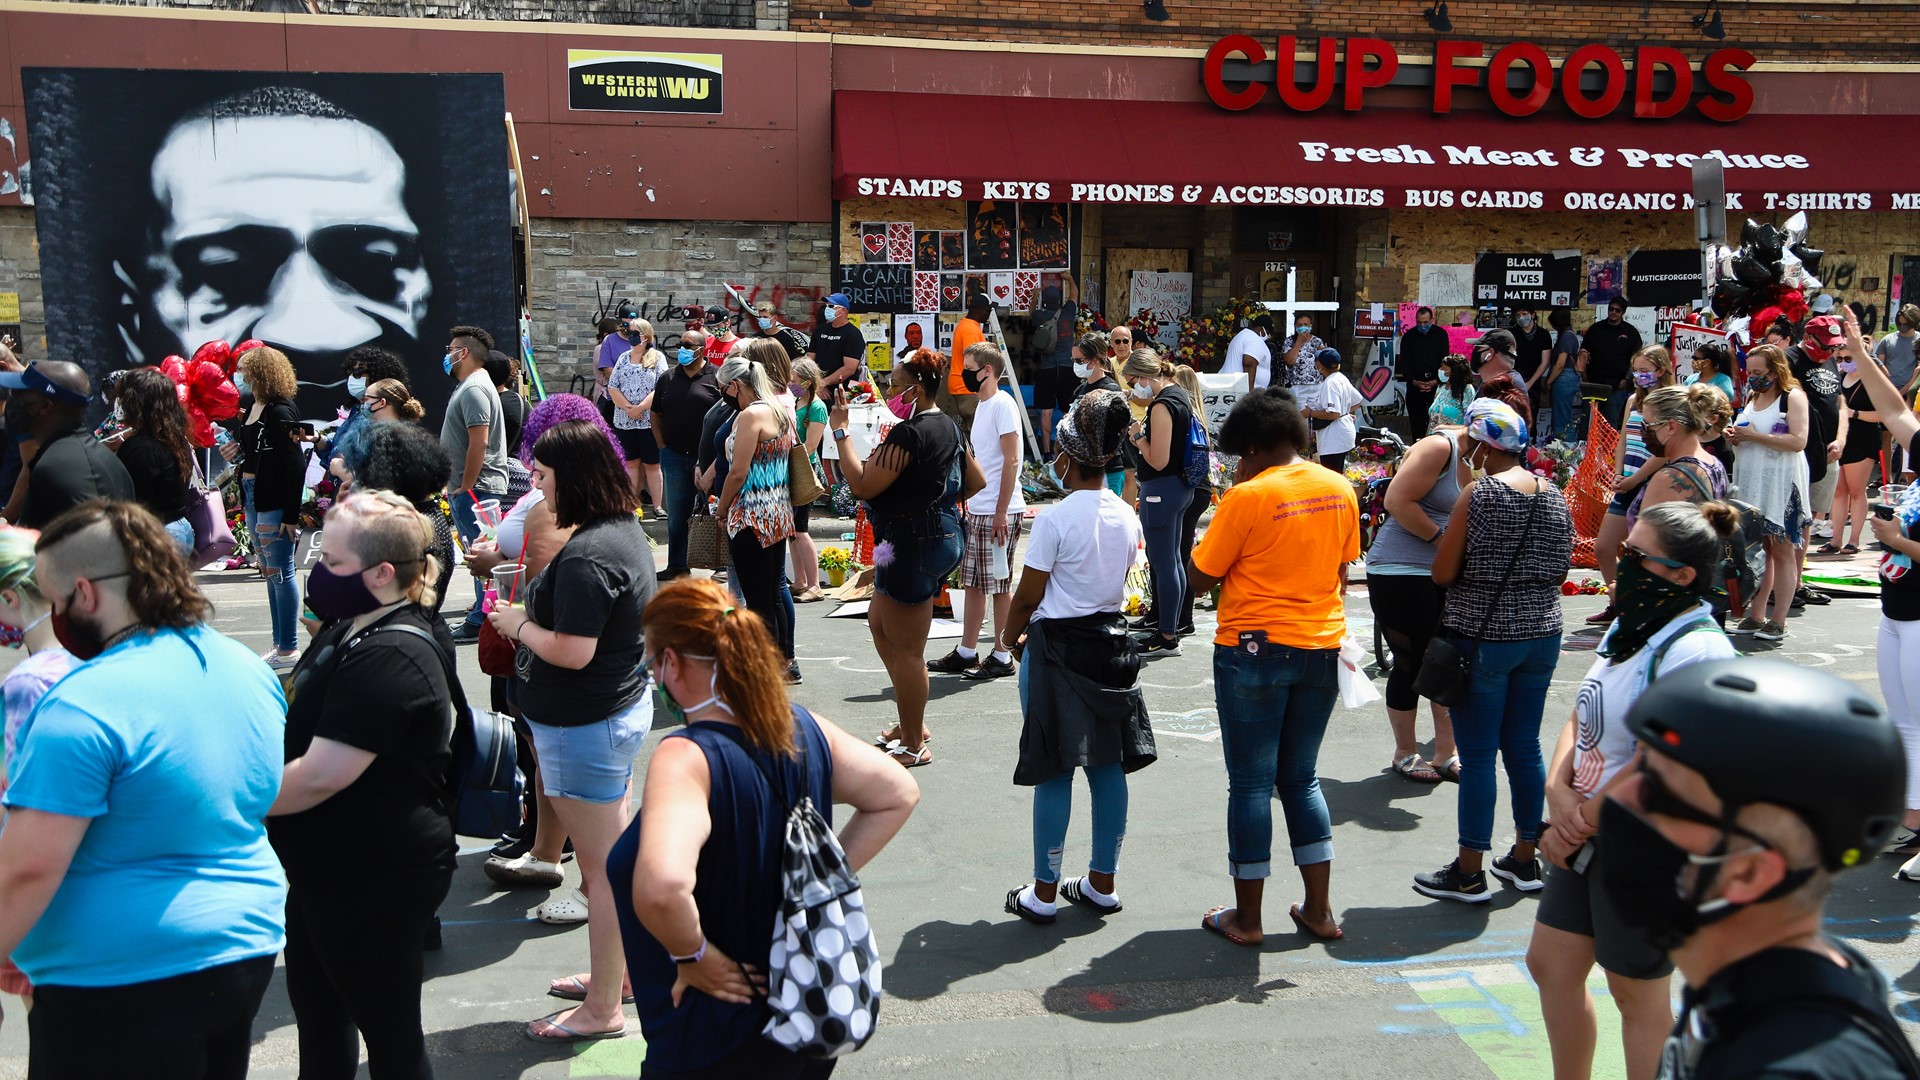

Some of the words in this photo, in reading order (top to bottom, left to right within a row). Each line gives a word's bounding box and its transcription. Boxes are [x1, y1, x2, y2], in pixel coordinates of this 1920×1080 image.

[582, 74, 657, 87] WESTERN
[1204, 34, 1399, 112] CUP
[1433, 40, 1757, 122] FOODS
[606, 86, 657, 98] UNION
[666, 77, 709, 99] WU
[1298, 141, 1434, 165] Fresh
[1442, 145, 1558, 168] Meat
[1570, 147, 1604, 167] &
[858, 177, 963, 198] STAMPS
[983, 181, 1050, 201] KEYS
[1071, 183, 1174, 203] PHONES
[1182, 186, 1203, 203] &
[1210, 186, 1384, 206] ACCESSORIES
[1405, 189, 1455, 208] BUS
[1461, 190, 1544, 209] CARDS
[1564, 192, 1675, 210] ORGANIC
[1682, 193, 1743, 210] MK
[1764, 193, 1872, 210] T-SHIRTS
[1507, 258, 1543, 268] BLACK
[841, 267, 854, 283] I
[1135, 273, 1150, 288] No
[1422, 272, 1458, 287] #TEAM
[1510, 274, 1540, 284] LIVES
[1631, 274, 1703, 282] #JUSTICEFORGEORG
[842, 286, 913, 305] BREATHE
[1133, 287, 1148, 303] No
[1425, 289, 1466, 303] HUMAN
[1504, 290, 1547, 300] MATTER
[1658, 307, 1686, 320] BLACK
[1658, 321, 1685, 334] LIV
